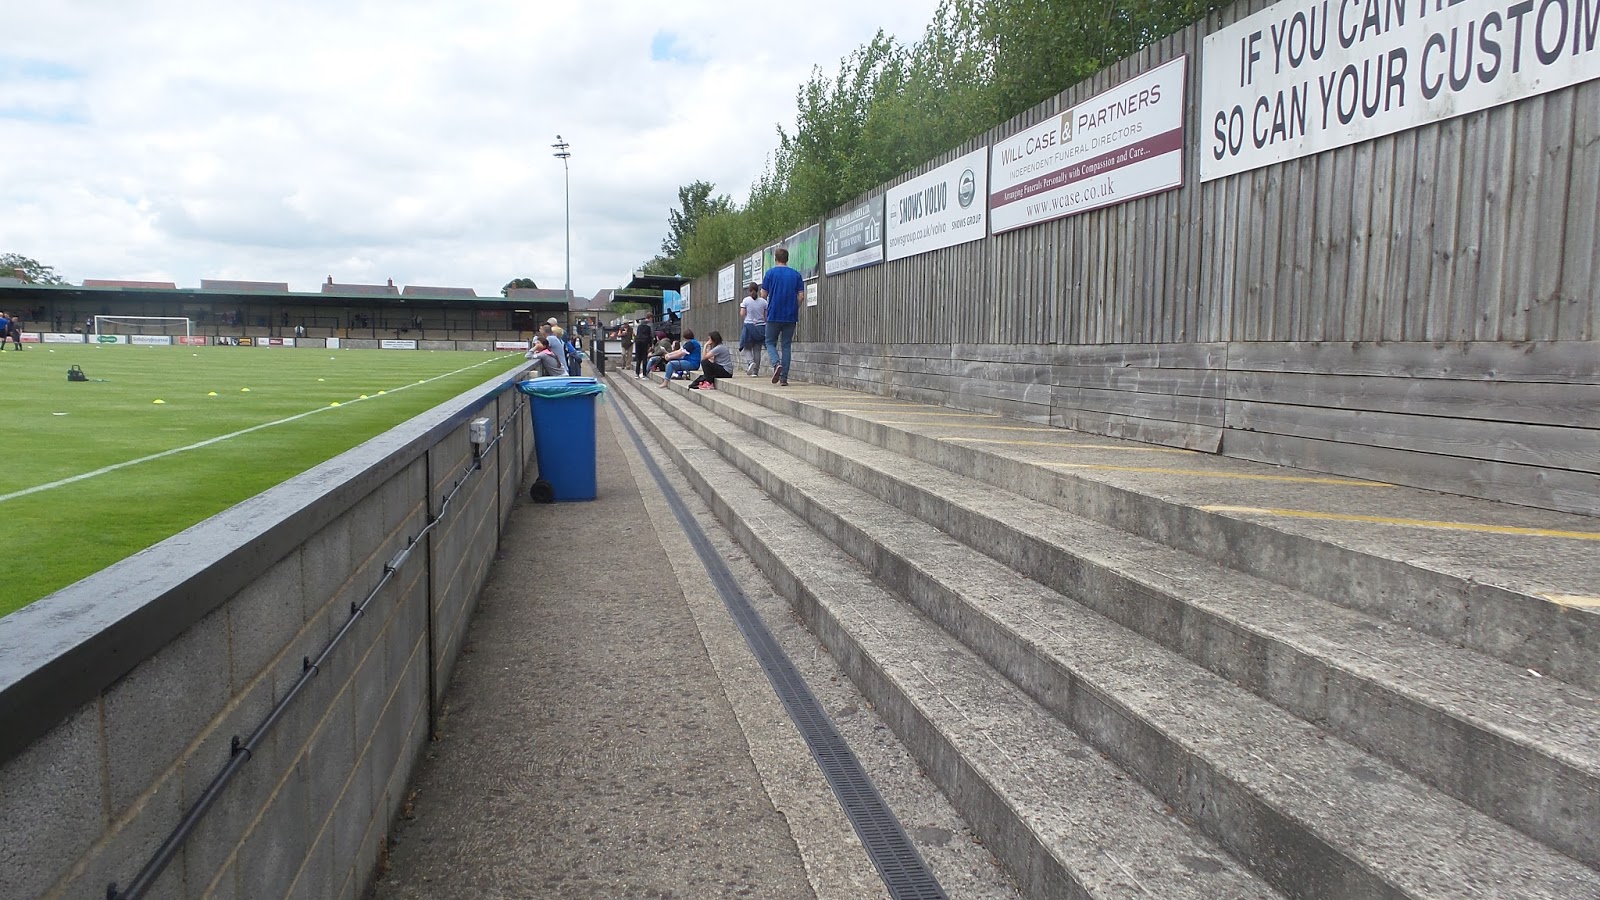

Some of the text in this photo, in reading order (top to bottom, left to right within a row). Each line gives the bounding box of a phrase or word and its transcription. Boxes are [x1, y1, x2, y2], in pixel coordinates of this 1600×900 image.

[1240, 31, 1262, 88] IF
[1270, 0, 1327, 75] YOU
[1062, 121, 1072, 141] &
[1078, 84, 1161, 135] PARTNERS
[1213, 104, 1244, 161] SO
[1252, 81, 1308, 150] CAN
[1318, 46, 1408, 131] YOUR
[1010, 122, 1143, 180] INDEPENDENT FUNERAL DIRECTORS
[1069, 166, 1081, 179] with
[1081, 157, 1115, 175] Compassion
[1116, 151, 1127, 164] and
[899, 191, 923, 225] SNOWS
[924, 181, 947, 217] VOLVO
[966, 213, 982, 227] GROUP
[1026, 177, 1114, 216] www.wcase.co.uk
